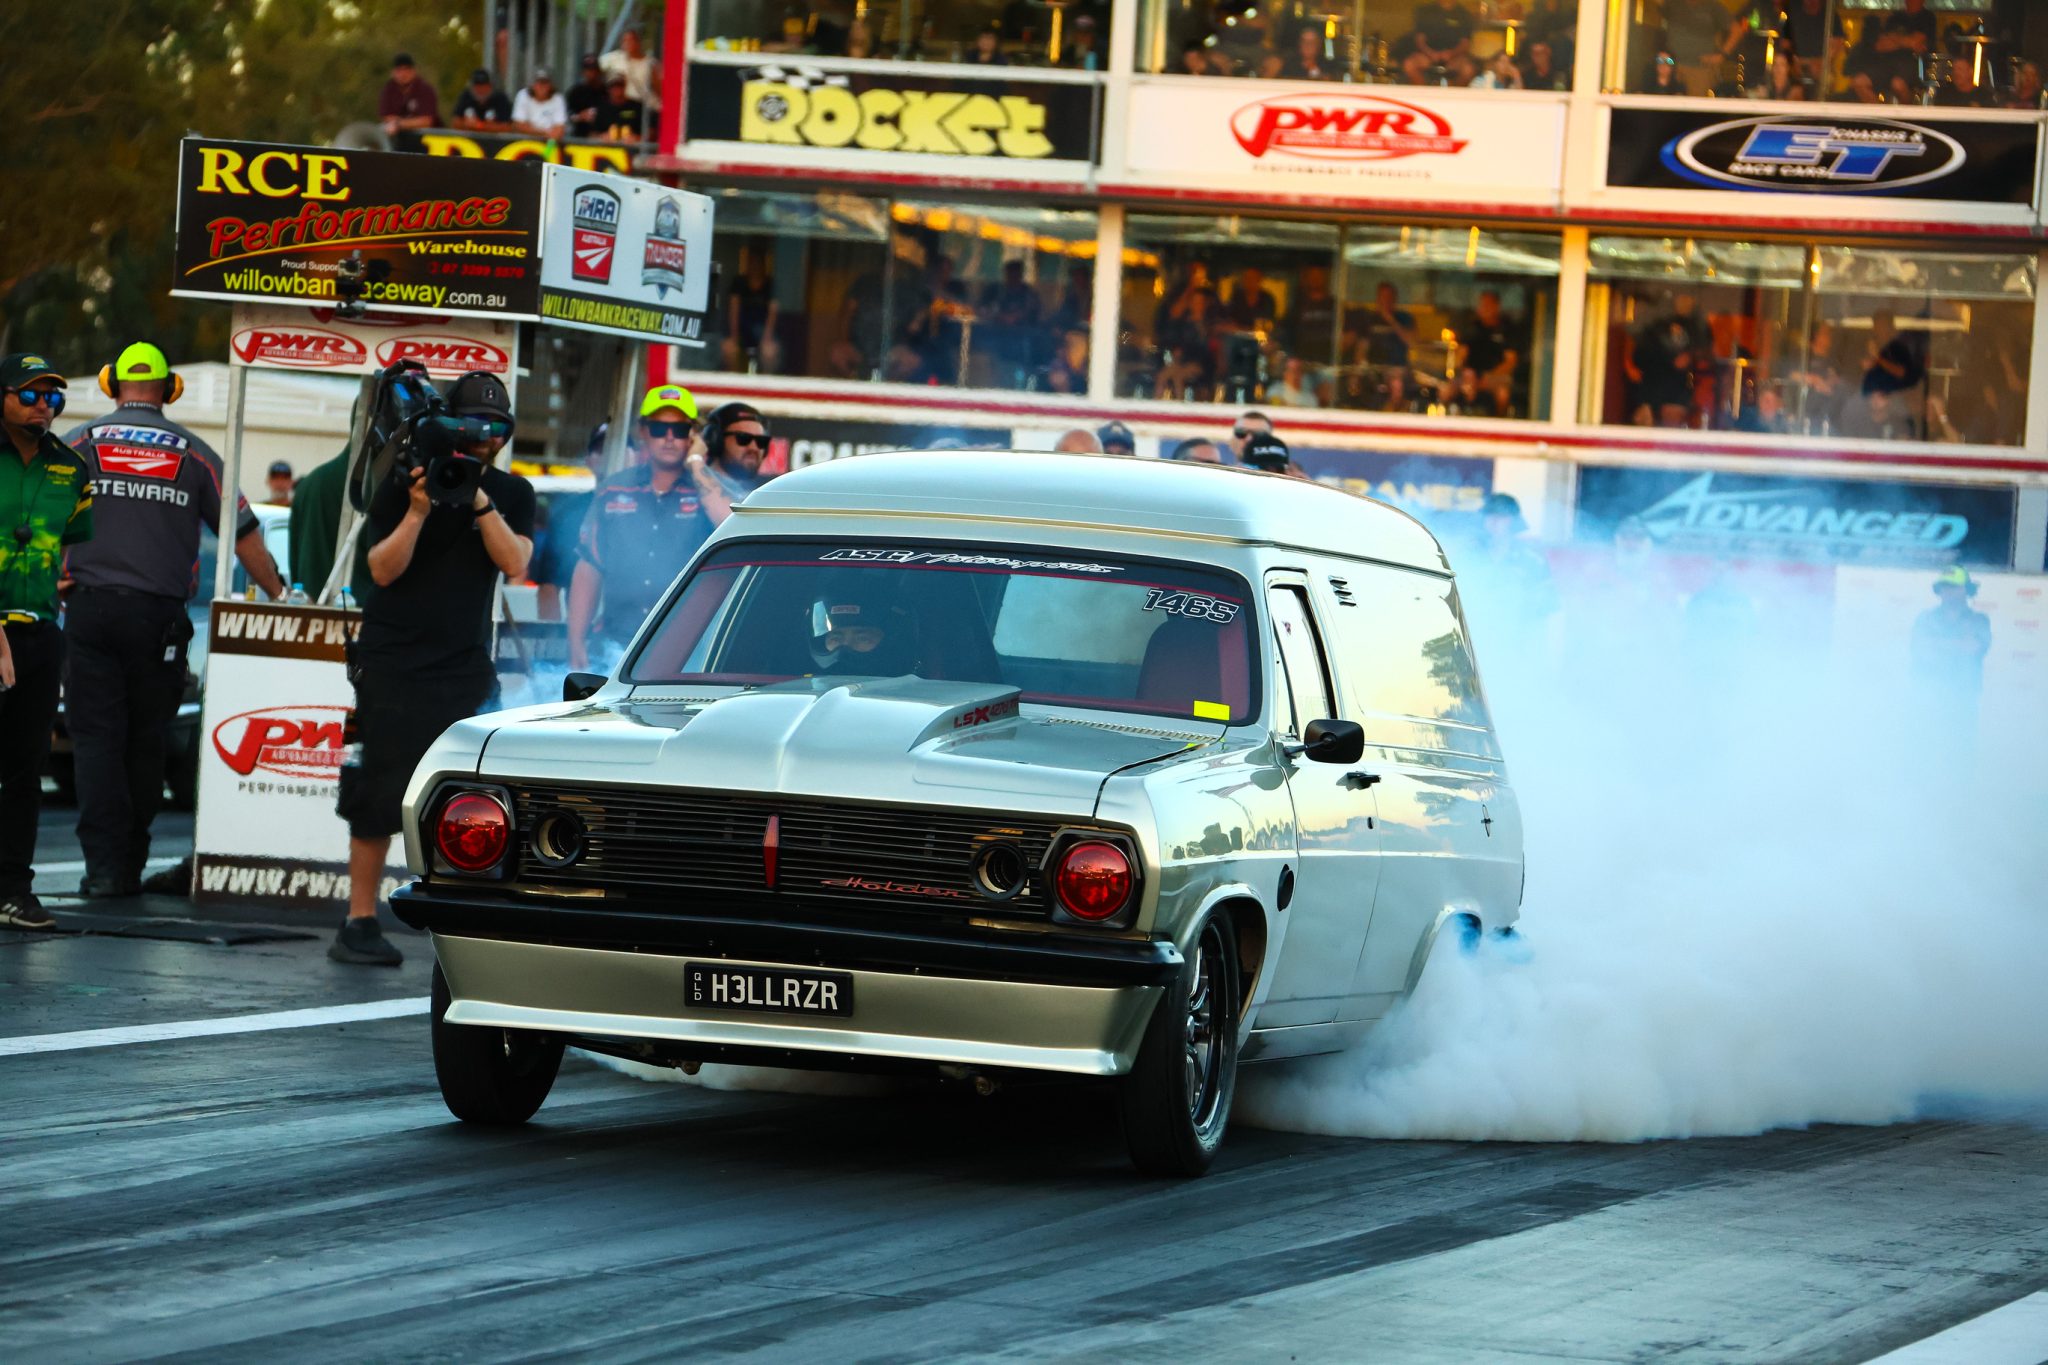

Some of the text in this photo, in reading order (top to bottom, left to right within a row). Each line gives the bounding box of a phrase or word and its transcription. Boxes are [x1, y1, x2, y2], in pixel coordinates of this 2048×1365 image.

[1244, 104, 1419, 158] PWR
[1736, 124, 1927, 181] ET
[197, 147, 350, 201] RCE
[206, 196, 510, 258] Performance
[408, 240, 527, 258] Warehouse
[280, 259, 307, 270] Proud
[243, 331, 345, 363] PWR
[385, 341, 487, 368] PWR
[100, 425, 180, 447] IHRA
[112, 446, 166, 458] AUSTRALIA
[89, 480, 189, 507] STEWARD
[1640, 472, 1969, 549] ADVANCED
[1143, 589, 1240, 624] 1465
[953, 706, 991, 729] LSX
[820, 876, 970, 899] Holden
[694, 972, 702, 1001] QLD
[711, 973, 838, 1011] H3LLRZR
